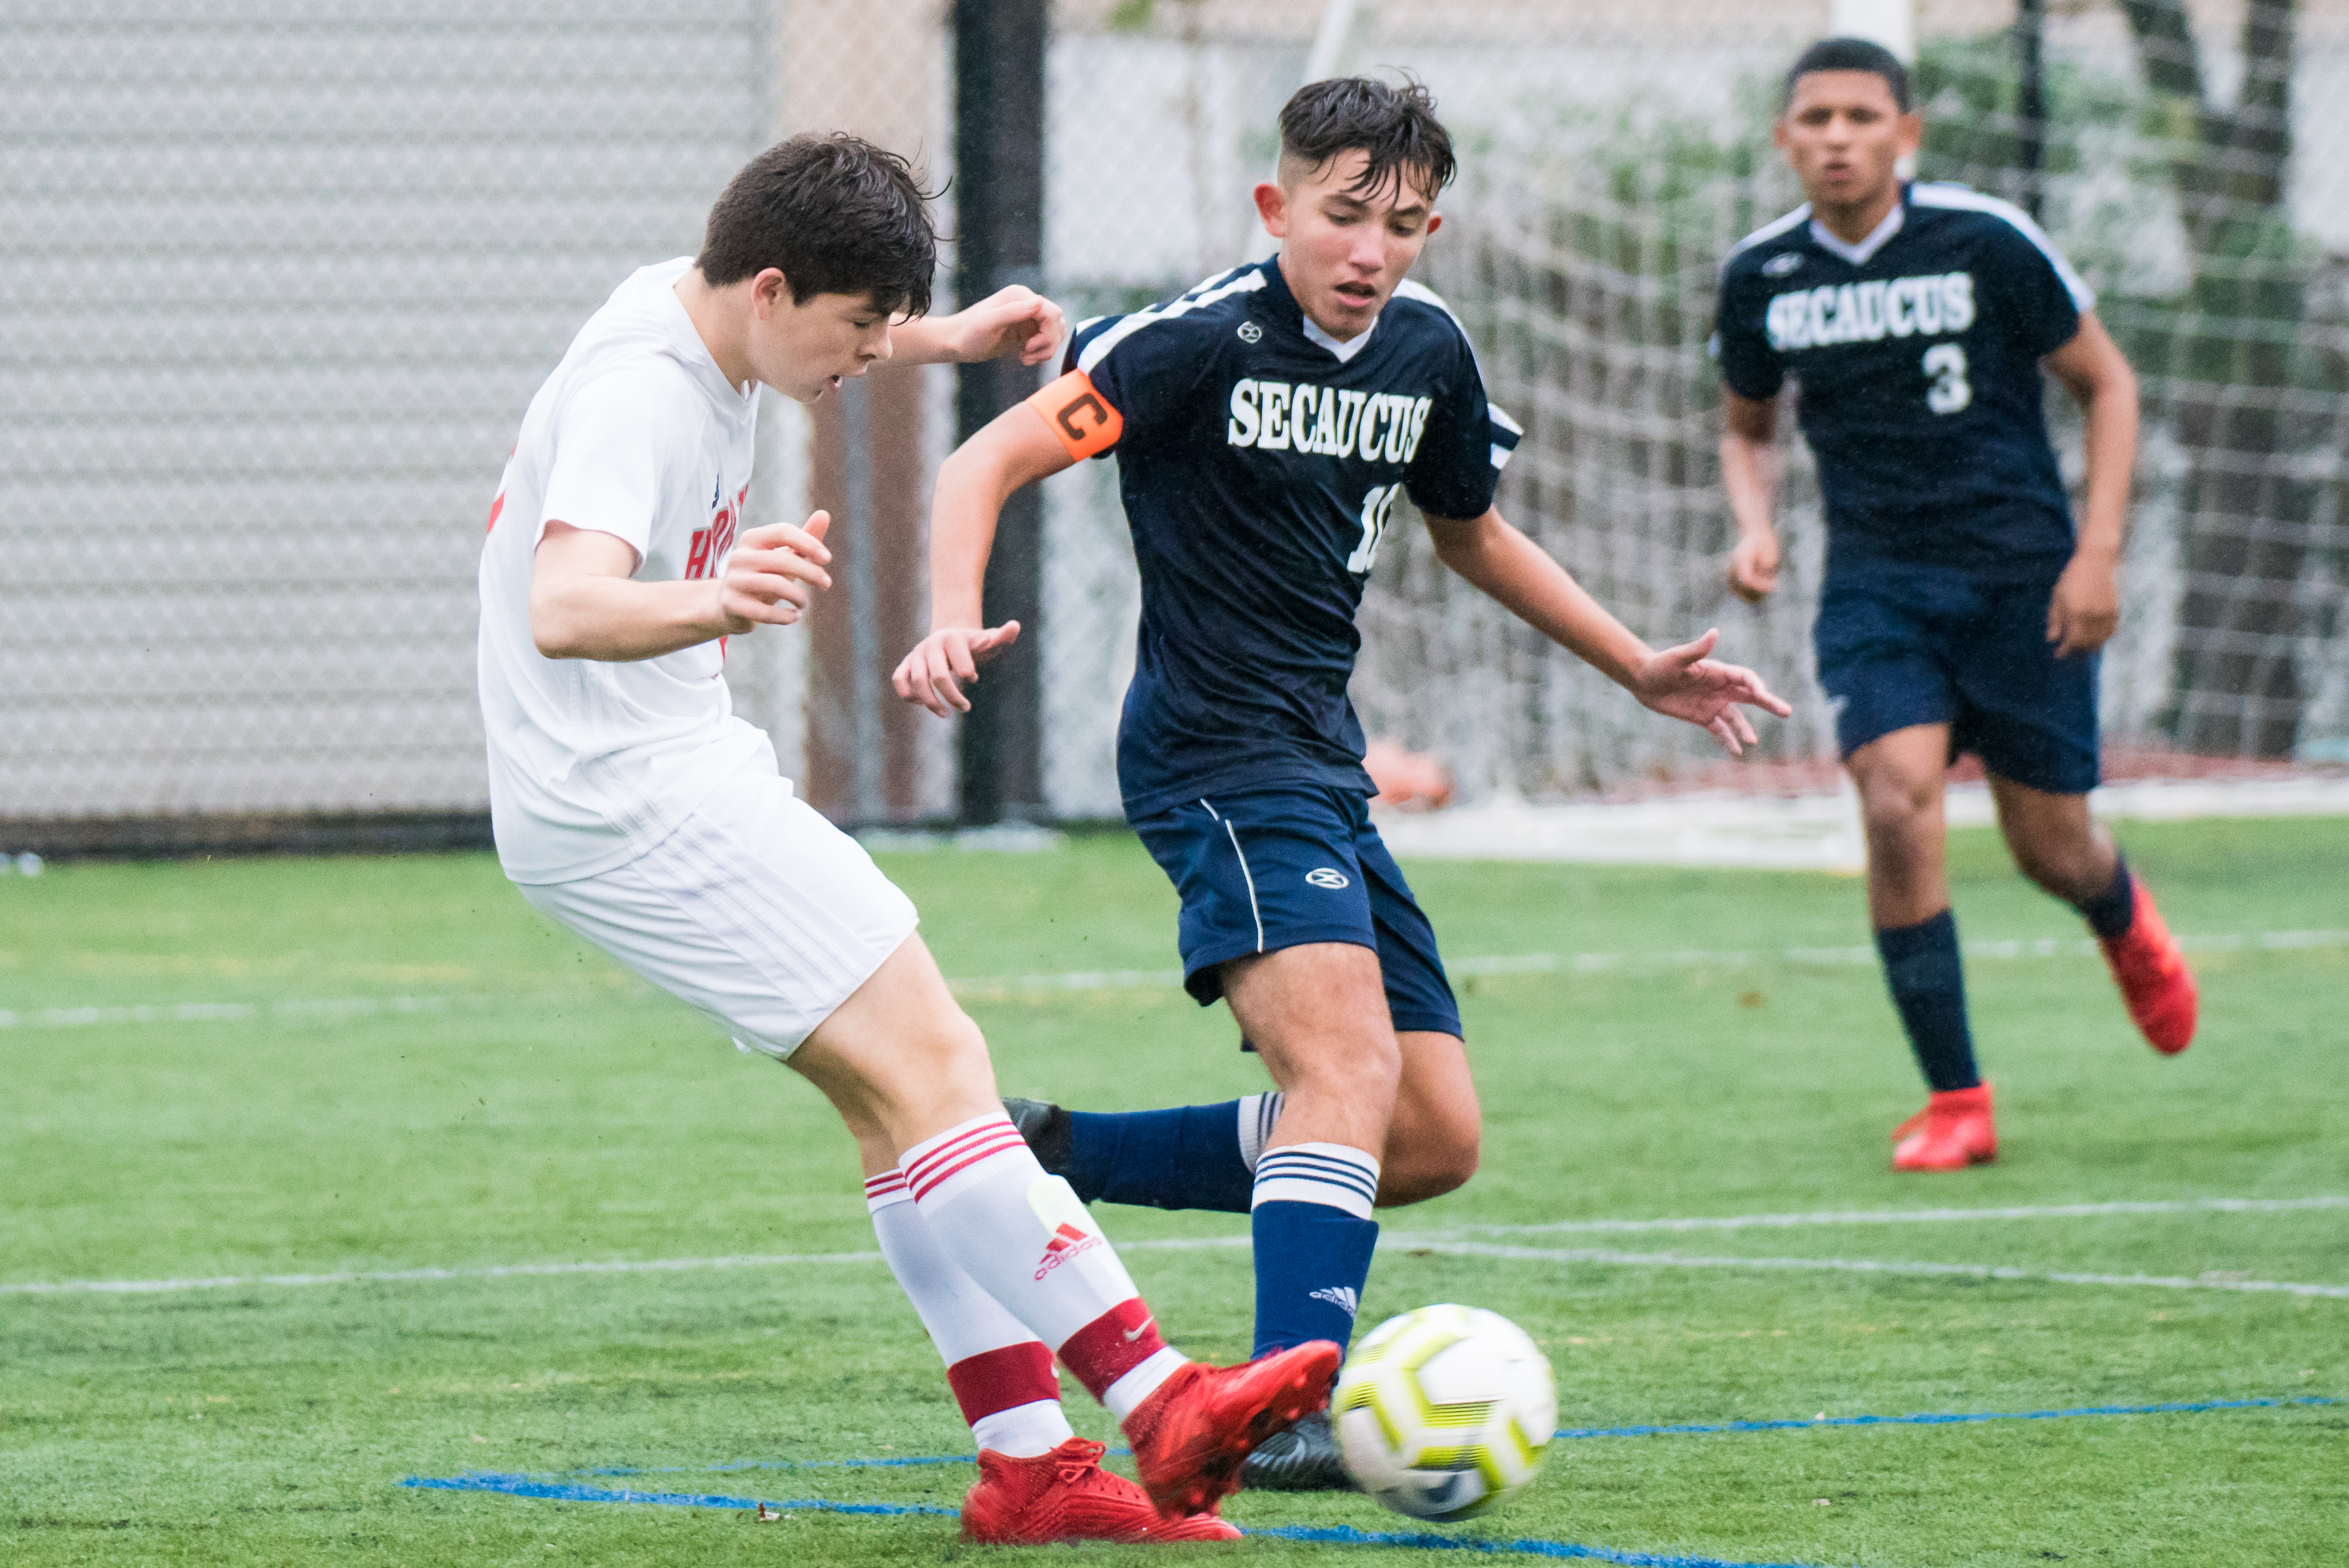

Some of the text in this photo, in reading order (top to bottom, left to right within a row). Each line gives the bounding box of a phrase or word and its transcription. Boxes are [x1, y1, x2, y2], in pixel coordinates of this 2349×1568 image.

[1765, 271, 1976, 352] SECAUCUS
[1057, 393, 1108, 440] C
[1921, 343, 1973, 414] 3
[1227, 378, 1432, 464] SECAUCUS
